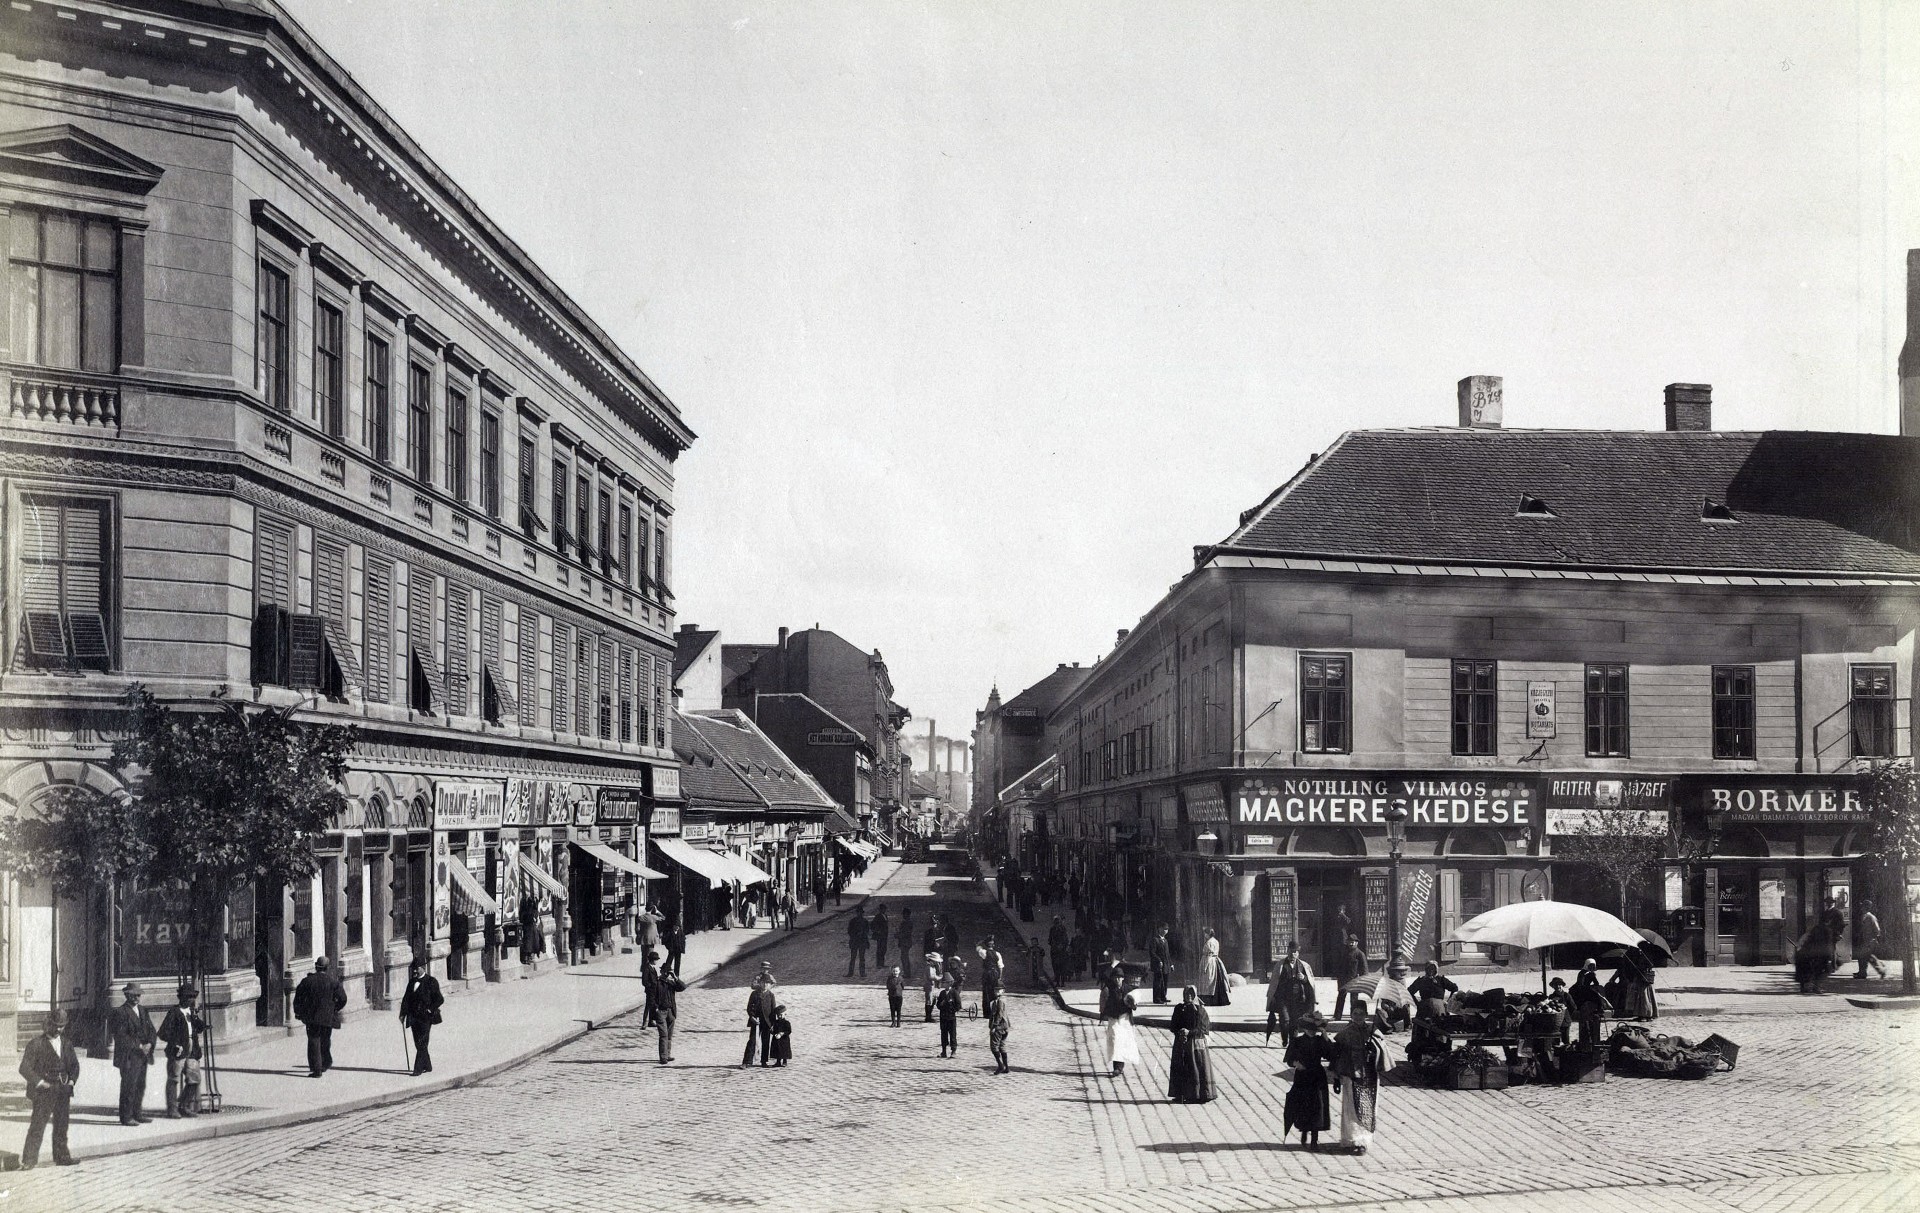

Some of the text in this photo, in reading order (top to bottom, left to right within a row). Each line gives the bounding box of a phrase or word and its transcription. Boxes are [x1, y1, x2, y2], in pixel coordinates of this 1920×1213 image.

[1284, 779, 1487, 797] NÖTHLING VILMOS
[1552, 781, 1592, 796] REITER
[1711, 787, 1866, 812] BORMÉR
